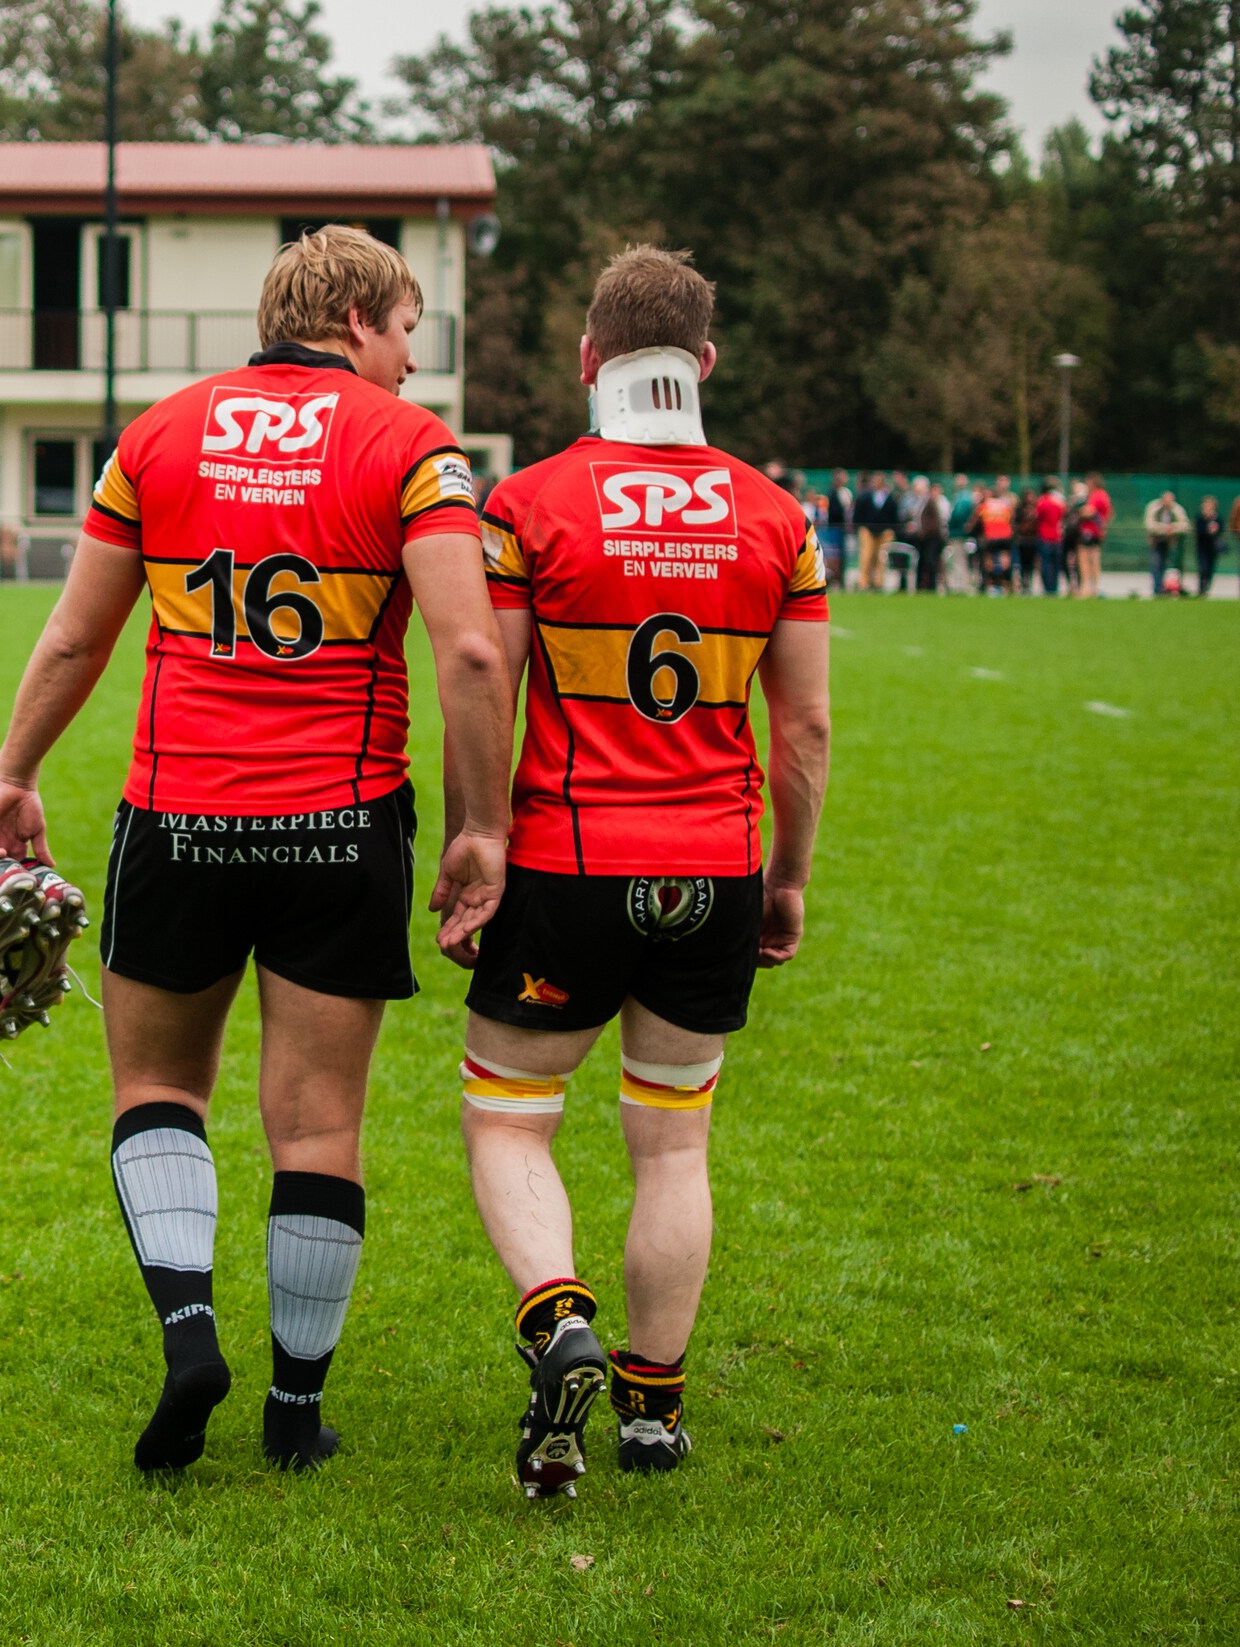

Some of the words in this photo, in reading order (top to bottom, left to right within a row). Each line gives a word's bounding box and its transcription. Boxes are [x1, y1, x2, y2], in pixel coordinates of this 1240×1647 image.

[203, 392, 339, 453] SPS
[198, 461, 322, 486] SIERPLEISTERS
[215, 483, 236, 500] EN
[240, 486, 306, 506] VERVEN
[602, 469, 731, 529] SPS
[602, 539, 739, 562] SIERPLEISTERS
[623, 560, 646, 577] EN
[650, 561, 719, 580] VERVEN
[184, 548, 325, 662] 16
[625, 612, 703, 725] 6
[158, 810, 372, 833] MASTERPIECE
[169, 832, 360, 864] FINANCIALS
[170, 1303, 217, 1325] KIPS
[633, 1426, 663, 1436] adidas
